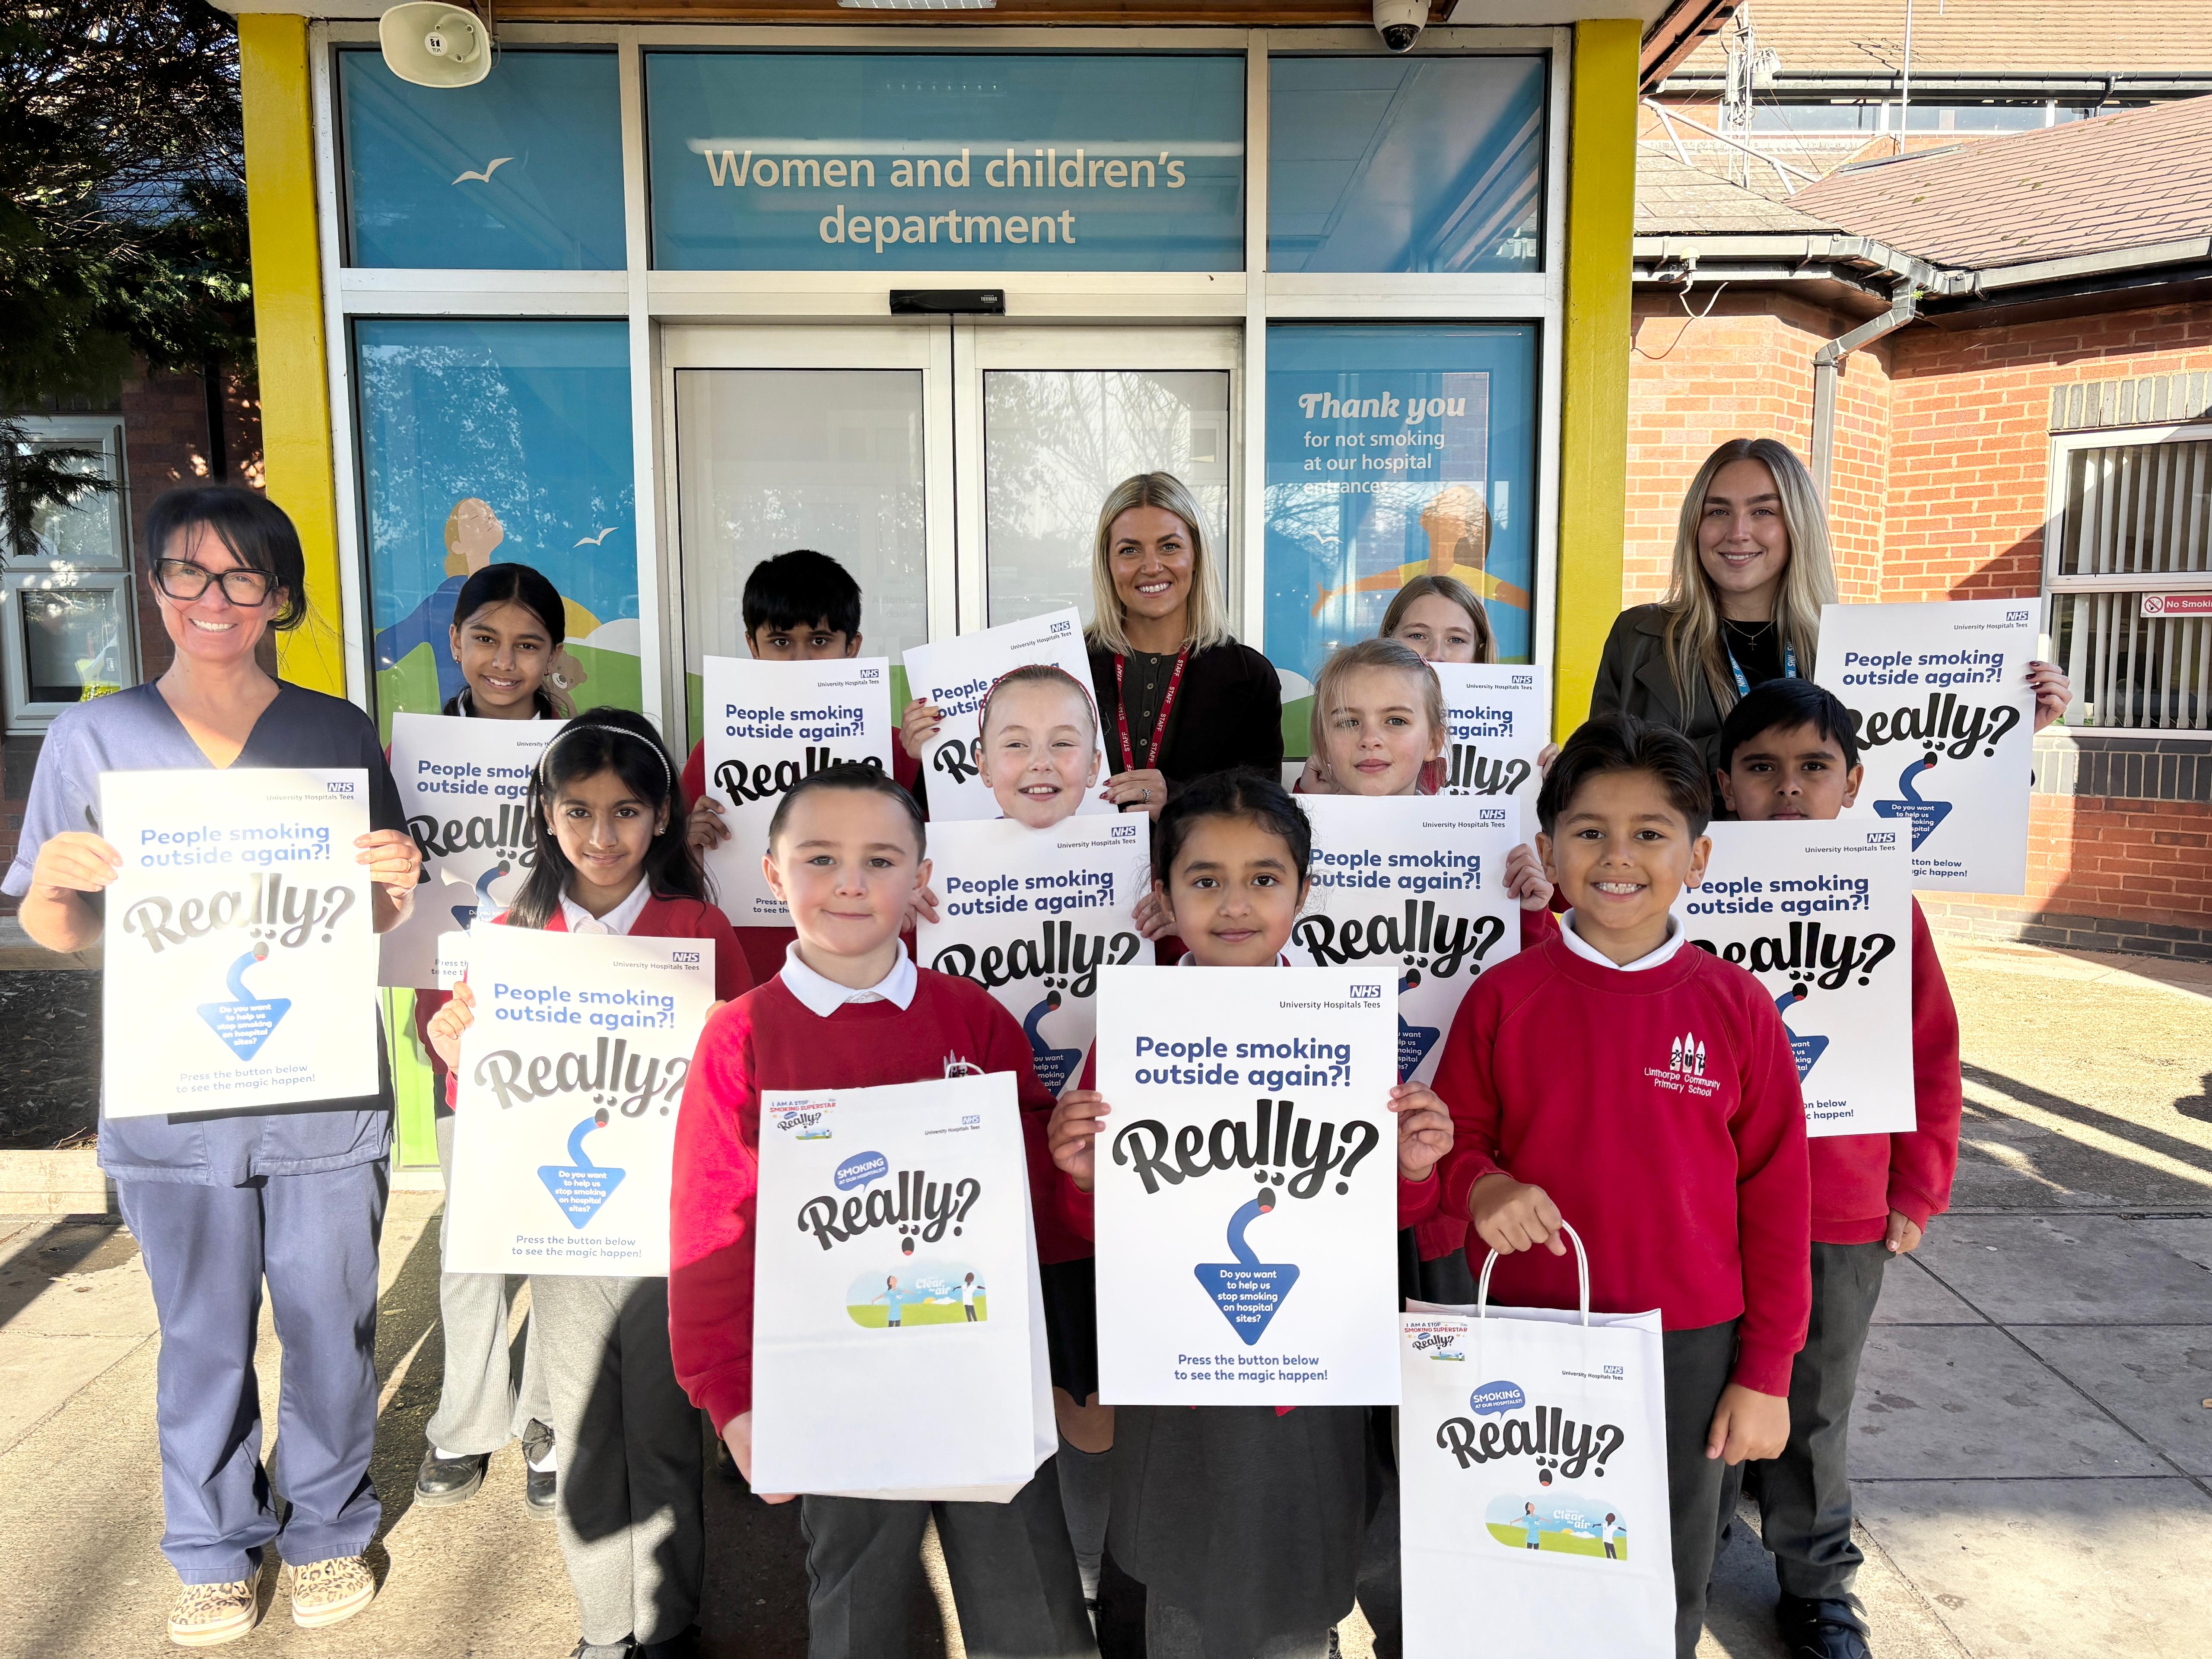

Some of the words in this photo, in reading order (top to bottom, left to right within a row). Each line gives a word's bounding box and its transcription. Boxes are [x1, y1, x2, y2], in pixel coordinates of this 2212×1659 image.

[703, 148, 875, 188] Women
[889, 147, 972, 188] and
[984, 147, 1187, 189] children's
[818, 204, 1077, 254] department
[1298, 391, 1400, 419] Thank
[1405, 397, 1466, 425] you
[1303, 431, 1331, 448] for
[1335, 432, 1365, 447] not
[1370, 430, 1445, 450] smoking
[1303, 456, 1322, 471] at
[1326, 457, 1357, 470] our
[1362, 453, 1431, 474] hospital
[1303, 479, 1389, 494] entrances
[2007, 611, 2028, 621] NHS
[1050, 620, 1071, 633] NHS
[1174, 659, 1184, 677] STAFF
[1845, 651, 1912, 670] People
[1919, 650, 2003, 667] smoking
[861, 669, 879, 677] NHS
[1512, 675, 1532, 683] NHS
[1843, 669, 1918, 685] outside
[1925, 668, 2002, 687] again?!
[932, 679, 988, 702] People
[1166, 686, 1175, 704] STAFF
[727, 704, 784, 724] People
[791, 705, 863, 721] smoking
[1157, 713, 1166, 731] STAFF
[726, 724, 793, 738] outside
[799, 722, 864, 742] again?!
[1447, 723, 1513, 740] again?!
[1149, 742, 1157, 763] STAFF
[419, 760, 481, 779] People
[327, 782, 354, 792] NHS
[417, 779, 488, 795] outside
[1480, 810, 1505, 820] NHS
[142, 826, 221, 847] People
[230, 823, 329, 843] smoking
[1112, 826, 1136, 836] NHS
[1867, 833, 1895, 843] NHS
[141, 847, 232, 867] outside
[242, 844, 330, 866] again?!
[1309, 849, 1381, 870] People
[1389, 851, 1480, 872] smoking
[947, 874, 1018, 896] People
[1026, 869, 1113, 889] smoking
[1311, 870, 1391, 888] outside
[1398, 871, 1480, 893] again?!
[1770, 874, 1868, 894] smoking
[948, 895, 1028, 915] outside
[1035, 889, 1114, 914] again?!
[1687, 897, 1773, 914] outside
[1781, 894, 1869, 916] again?!
[123, 872, 356, 953] Really?
[1292, 899, 1506, 979] Really?
[673, 952, 700, 962] NHS
[495, 983, 571, 1004] People
[579, 989, 674, 1011] smoking
[1350, 985, 1381, 998] NHS
[1280, 1001, 1321, 1010] University
[1324, 1001, 1360, 1009] Hospitals
[496, 1006, 581, 1024] outside
[590, 1010, 674, 1030] again?!
[1137, 1036, 1227, 1063] People
[1236, 1038, 1350, 1065] smoking
[235, 1068, 272, 1077] button
[276, 1065, 308, 1073] below
[474, 1036, 691, 1118] Really?
[1135, 1063, 1239, 1085] outside
[1248, 1064, 1350, 1091] again?!
[1644, 1067, 1680, 1080] Linthorpe
[1684, 1074, 1720, 1091] Community
[235, 1078, 268, 1088] magic
[272, 1074, 315, 1086] happen!
[1655, 1078, 1684, 1093] Primary
[1688, 1085, 1712, 1096] School
[962, 1115, 980, 1124] NHS
[1112, 1098, 1380, 1200] Really?
[837, 1158, 884, 1179] SMOKING
[798, 1170, 981, 1251] Really?
[1220, 1270, 1233, 1278] Do
[1239, 1281, 1258, 1291] help
[1218, 1293, 1238, 1302] stop
[1240, 1292, 1278, 1302] smoking
[1237, 1303, 1273, 1313] hospital
[1412, 1335, 1455, 1351] Really?
[1179, 1354, 1211, 1364] Press
[1215, 1354, 1234, 1365] the
[1238, 1354, 1279, 1365] button
[1283, 1354, 1319, 1365] below
[1175, 1370, 1187, 1380] to
[1215, 1370, 1234, 1380] the
[1239, 1370, 1275, 1383] magic
[1279, 1370, 1327, 1382] happen!
[1604, 1366, 1623, 1374] NHS
[1474, 1389, 1520, 1403] SMOKING
[1436, 1405, 1624, 1478] Really?
[1553, 1510, 1584, 1521] Clear
[1574, 1519, 1590, 1529] air
